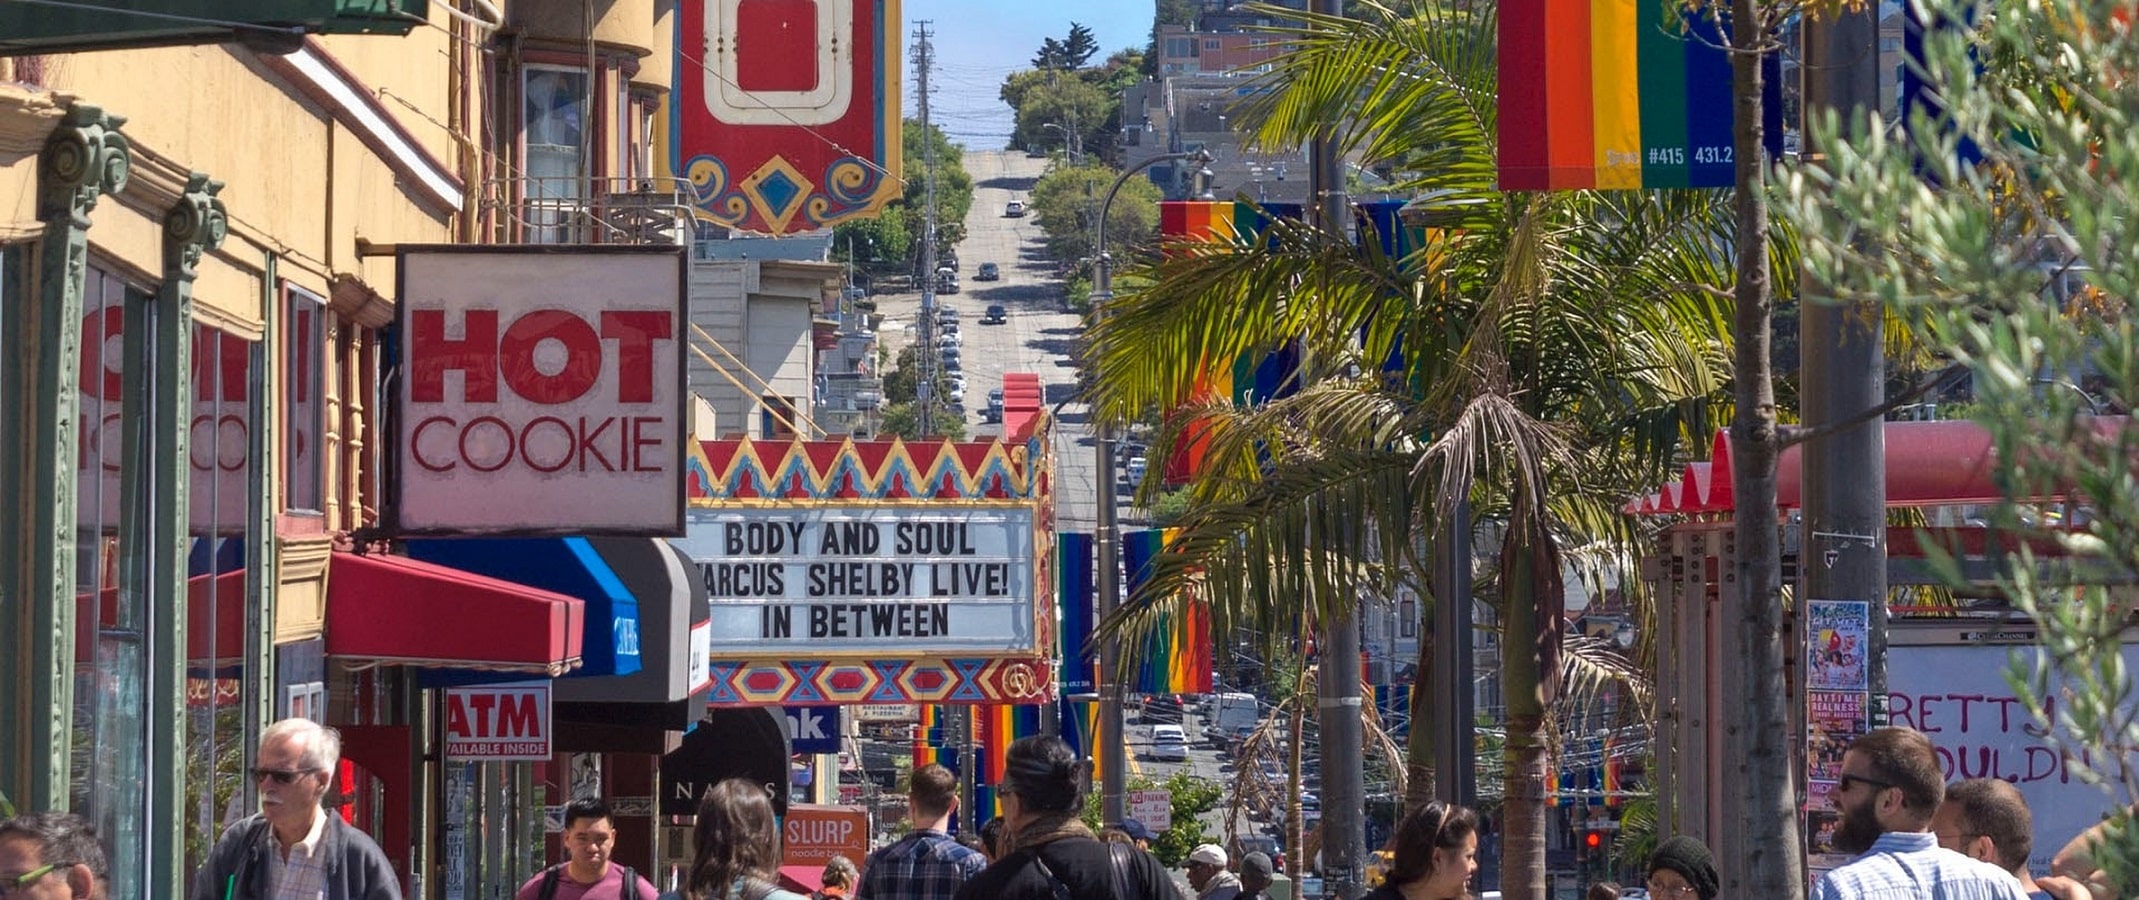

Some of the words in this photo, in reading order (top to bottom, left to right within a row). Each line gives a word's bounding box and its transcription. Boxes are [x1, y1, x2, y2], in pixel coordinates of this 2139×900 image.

[1648, 147, 1684, 164] #415
[411, 309, 671, 404] HOT
[411, 415, 662, 472] COOKIE
[726, 522, 805, 555] BODY
[821, 522, 880, 555] AND
[897, 522, 975, 555] SOUL
[697, 563, 784, 597] ARCUS
[808, 563, 914, 597] SHELBY
[932, 563, 1008, 596] LIVE!
[763, 605, 791, 638] IN
[810, 605, 948, 638] BETWEEN
[1811, 693, 1860, 702] DAYTIME
[1811, 702, 1860, 712] REALNESS
[448, 694, 540, 737] ATM
[787, 708, 826, 738] nk
[1888, 691, 2055, 738] RETTY
[447, 744, 500, 755] AILABLE
[504, 744, 545, 754] INSIDE
[676, 782, 775, 800] NAS
[1131, 792, 1142, 802] NO
[788, 820, 853, 844] SLURP
[792, 848, 825, 858] noodle
